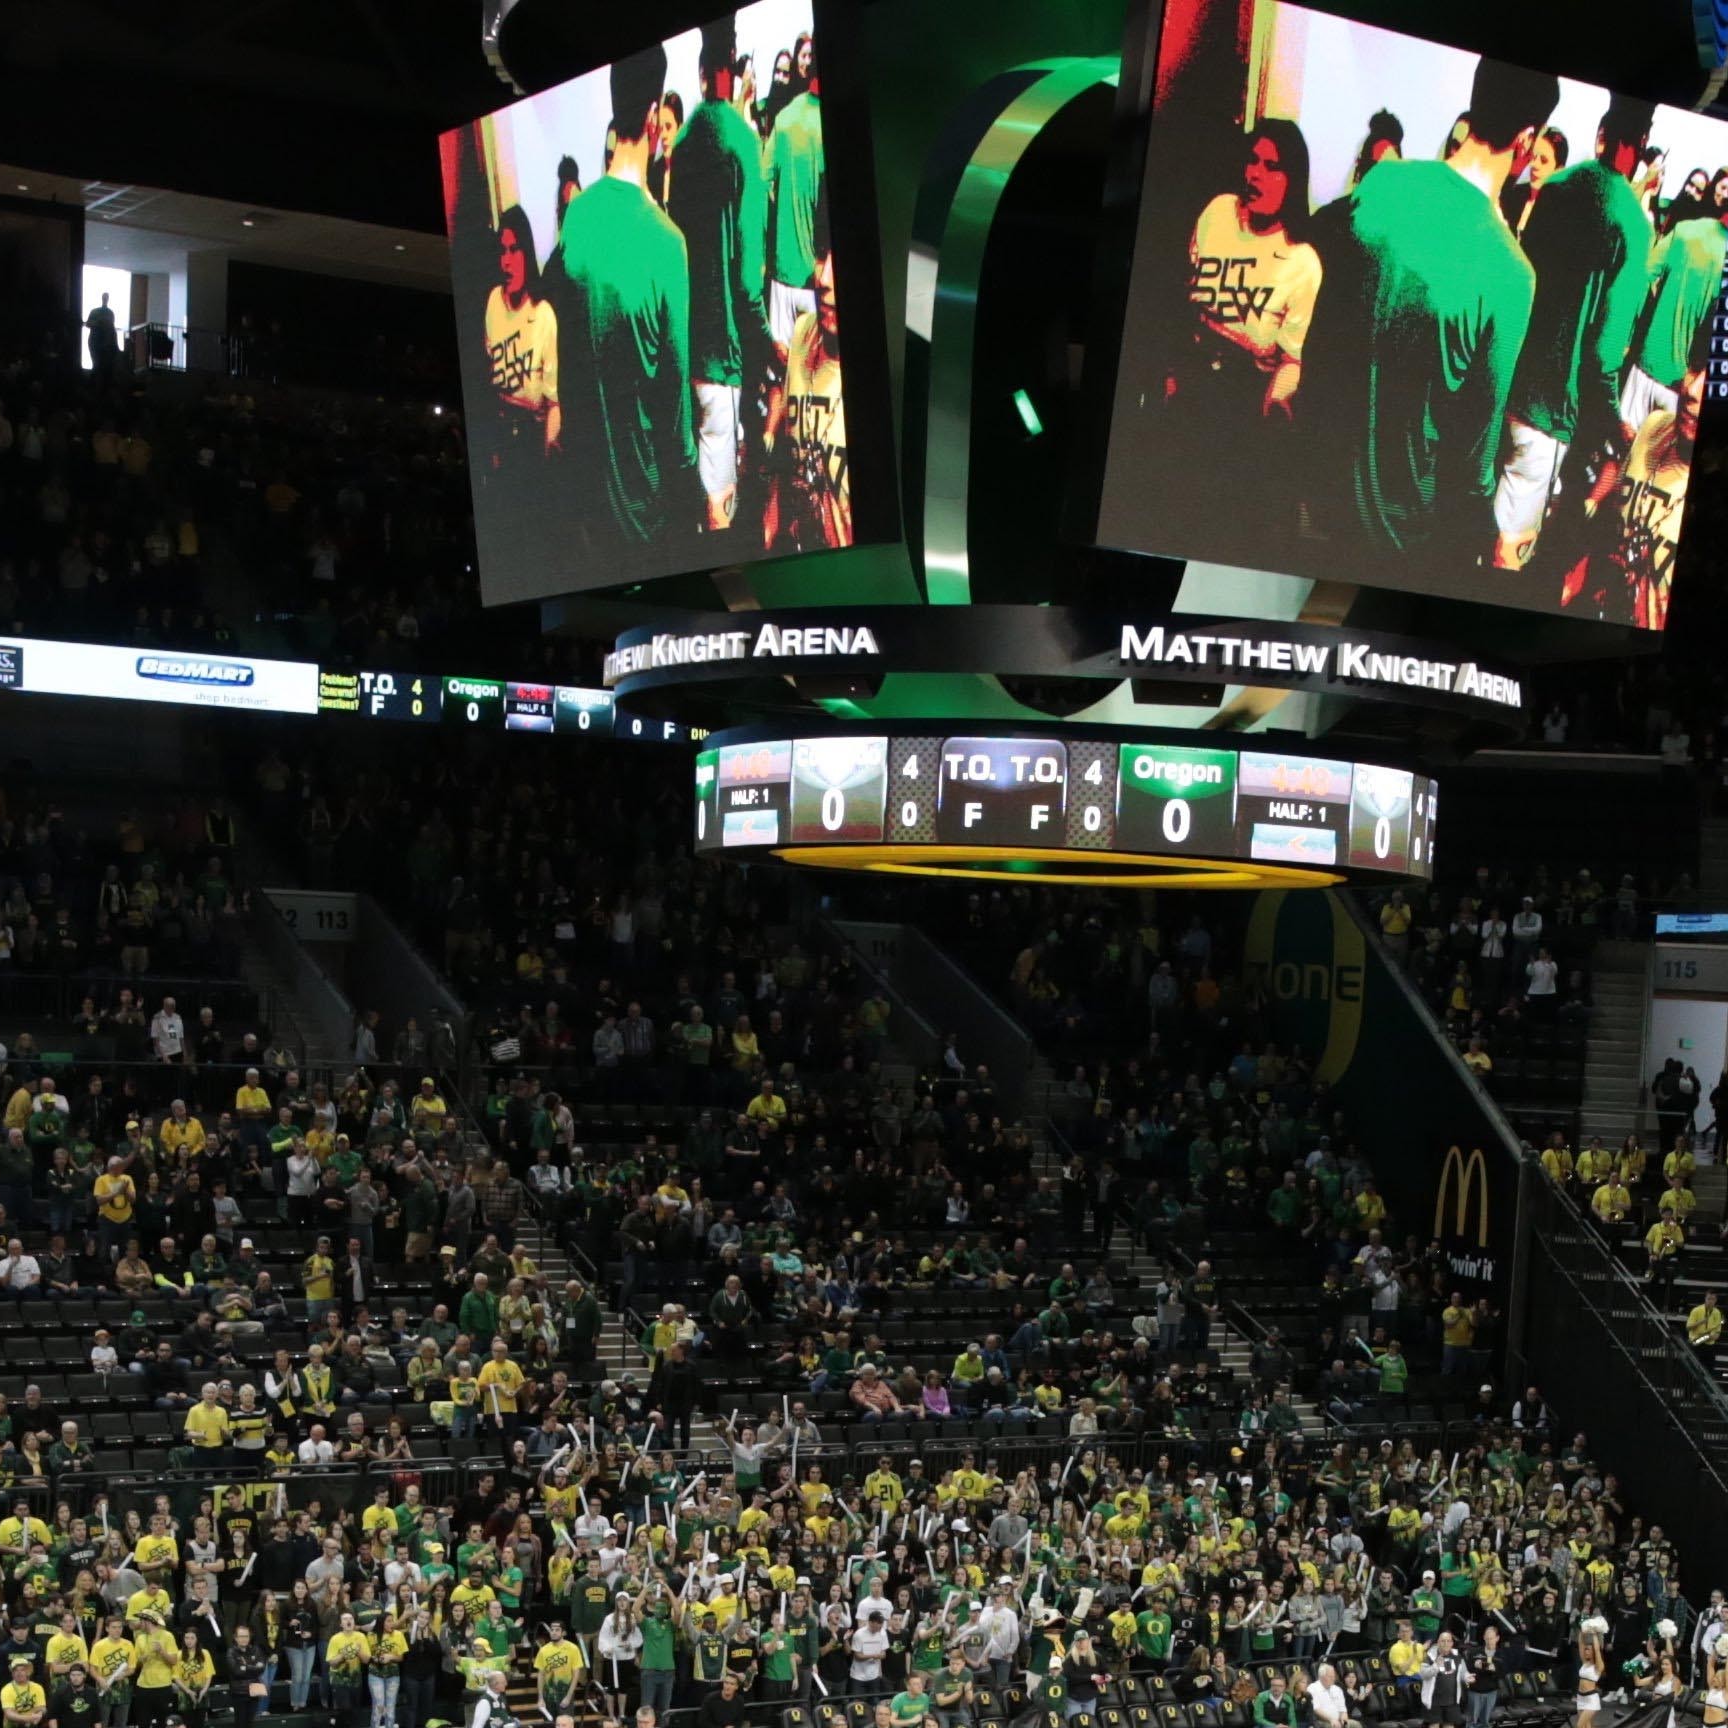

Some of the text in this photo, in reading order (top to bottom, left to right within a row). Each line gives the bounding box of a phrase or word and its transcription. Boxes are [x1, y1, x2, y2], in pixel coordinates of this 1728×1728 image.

[1719, 383, 1728, 397] 0
[652, 632, 747, 667] KNIGHT
[752, 624, 877, 657] ARENA
[1121, 625, 1521, 708] MATTHEW KNIGHT ARENA
[360, 672, 423, 695] T.O. 4
[448, 679, 499, 698] Oregon
[371, 695, 423, 716] F 0
[467, 703, 479, 721] 0
[578, 711, 590, 729] 0
[632, 719, 675, 739] 0 F
[903, 755, 918, 780] 4
[945, 754, 1064, 783] T.O. T.O.
[1084, 760, 1102, 784] 4
[1134, 755, 1222, 786] Oregon
[822, 789, 845, 831] 0
[902, 802, 917, 827] 0
[1319, 807, 1326, 822] 1
[1415, 793, 1423, 815] 4
[964, 803, 1049, 829] F F
[1084, 807, 1101, 831] 0
[1162, 799, 1191, 842] 0
[1375, 817, 1390, 858] 0
[1414, 838, 1421, 860] 0
[317, 911, 348, 929] 113
[1664, 960, 1697, 978] 115
[1446, 1249, 1481, 1280] ovin'
[879, 1484, 893, 1501] 21
